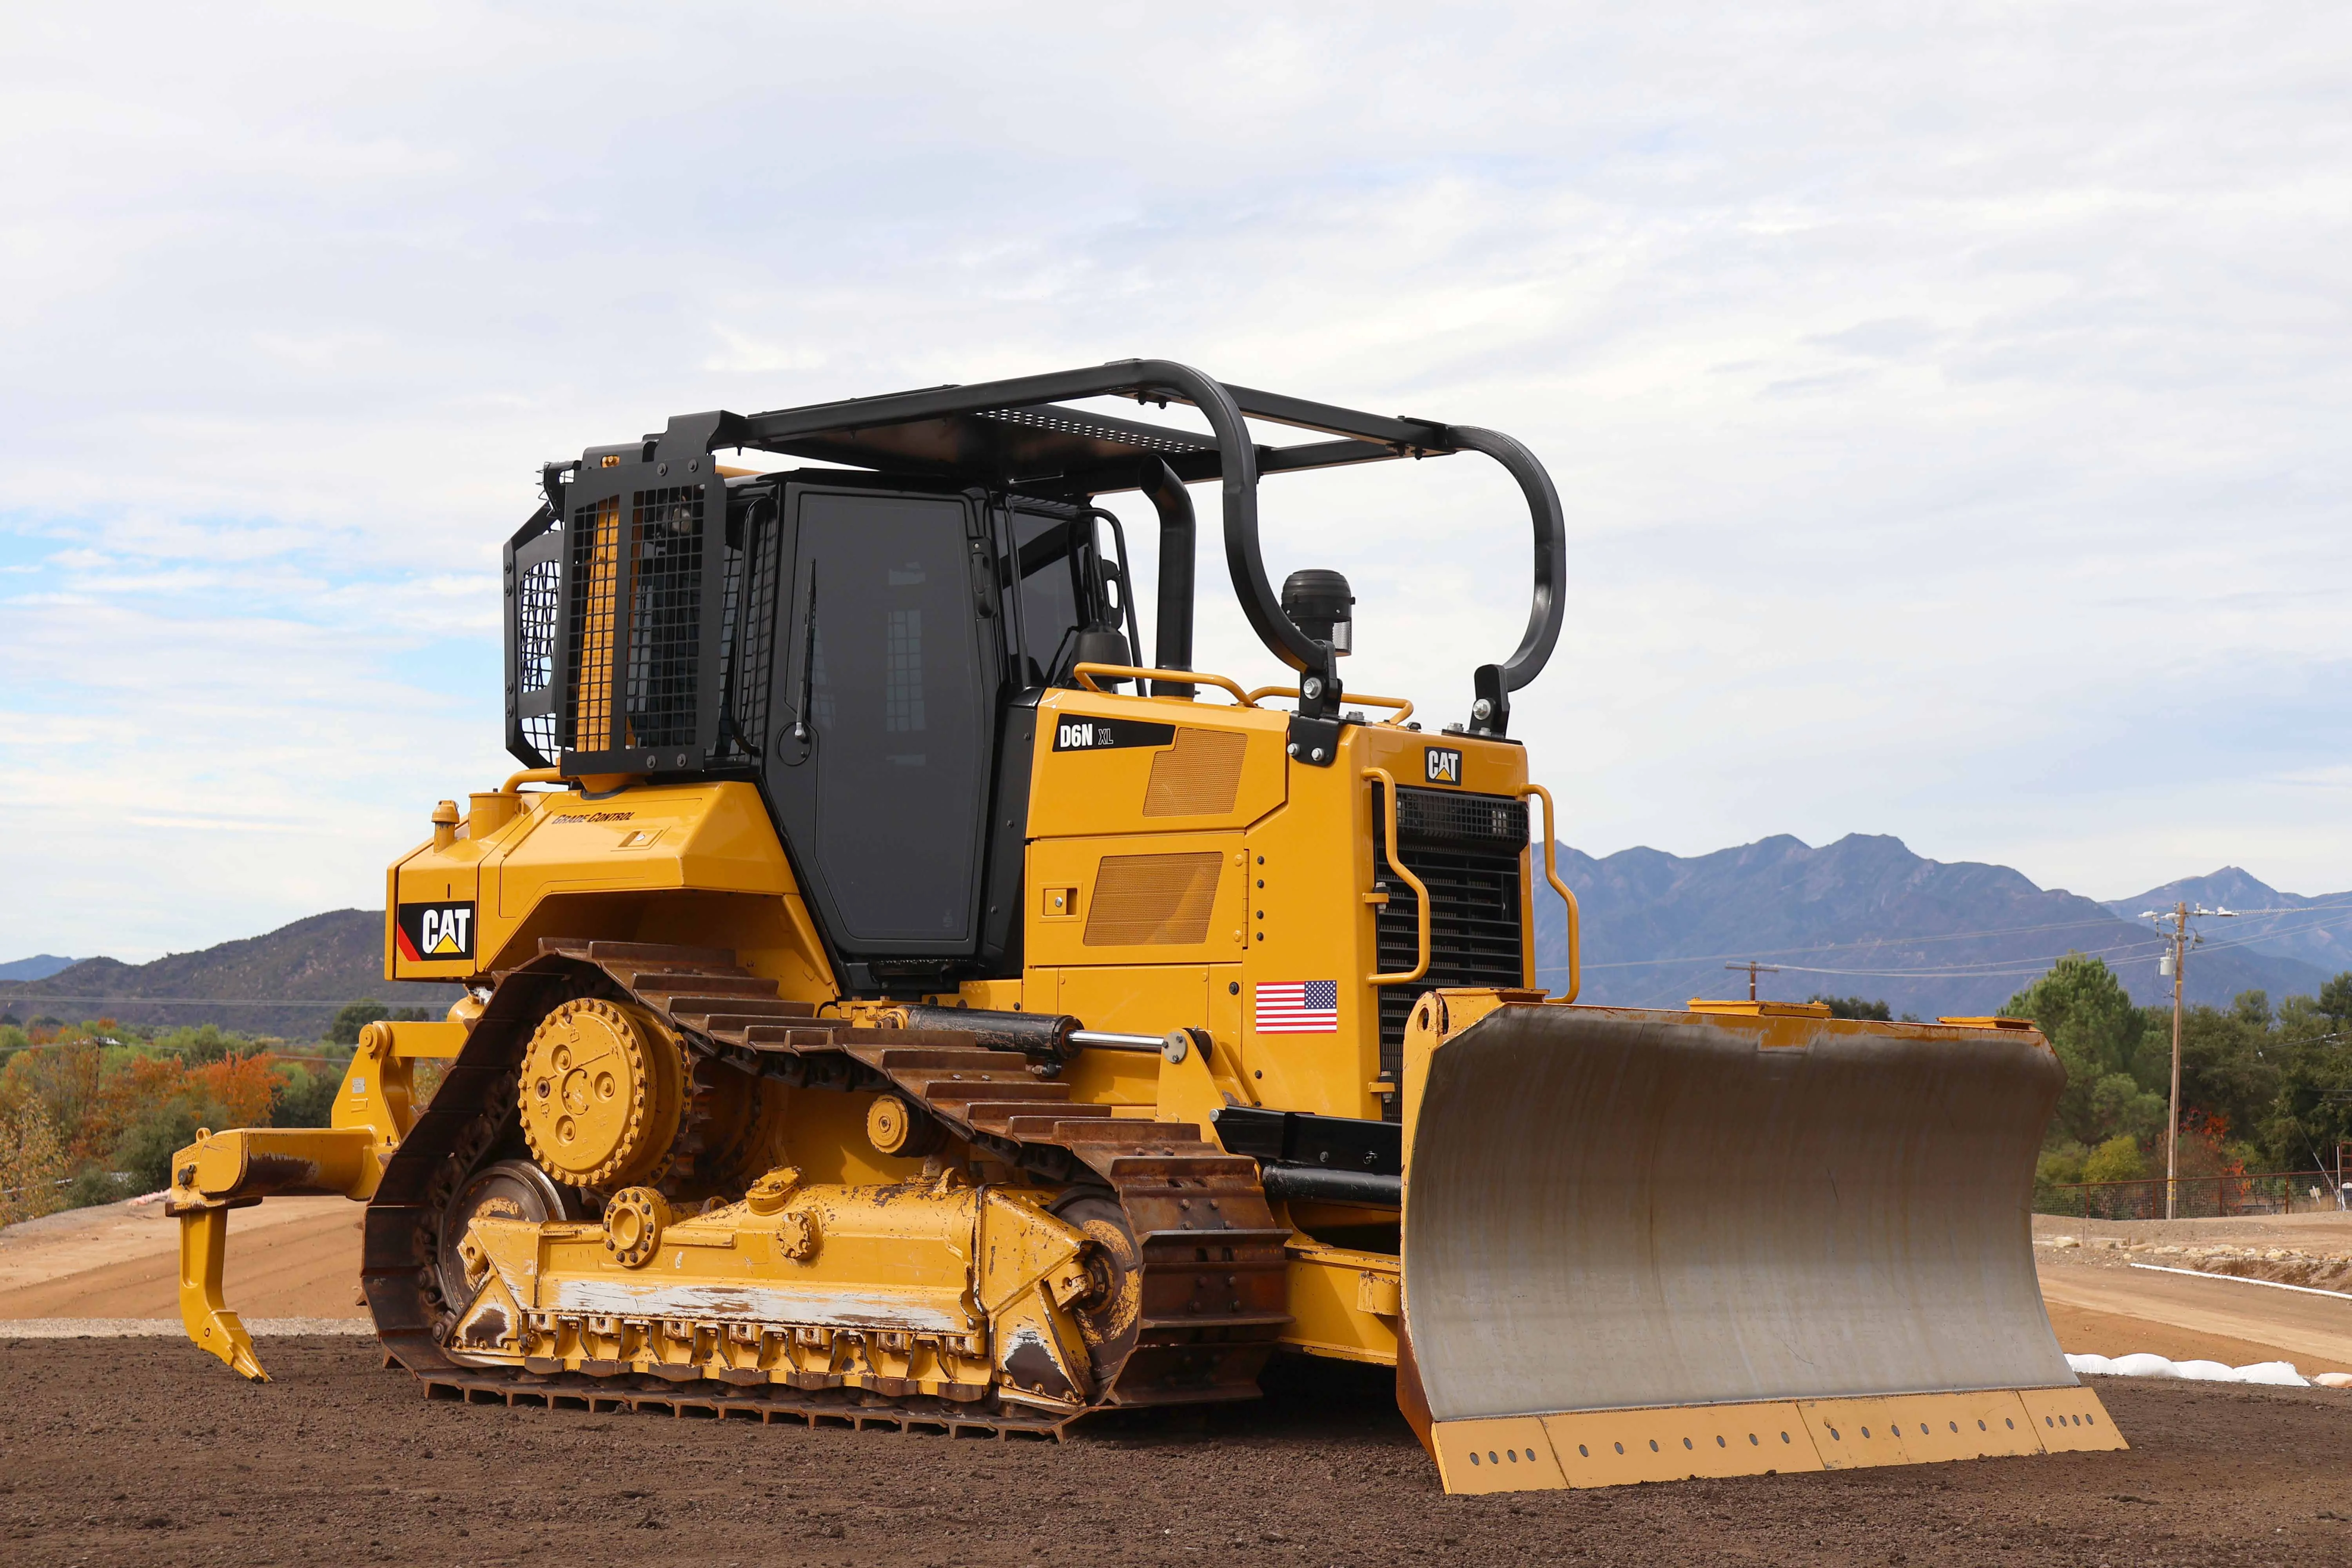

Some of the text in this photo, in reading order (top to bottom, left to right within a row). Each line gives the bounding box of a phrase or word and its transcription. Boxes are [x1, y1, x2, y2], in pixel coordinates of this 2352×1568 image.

[1060, 724, 1114, 747] D6N XL
[1428, 750, 1458, 782] CAT
[551, 812, 635, 824] GRADE CONTROL
[423, 909, 470, 953] CAT
